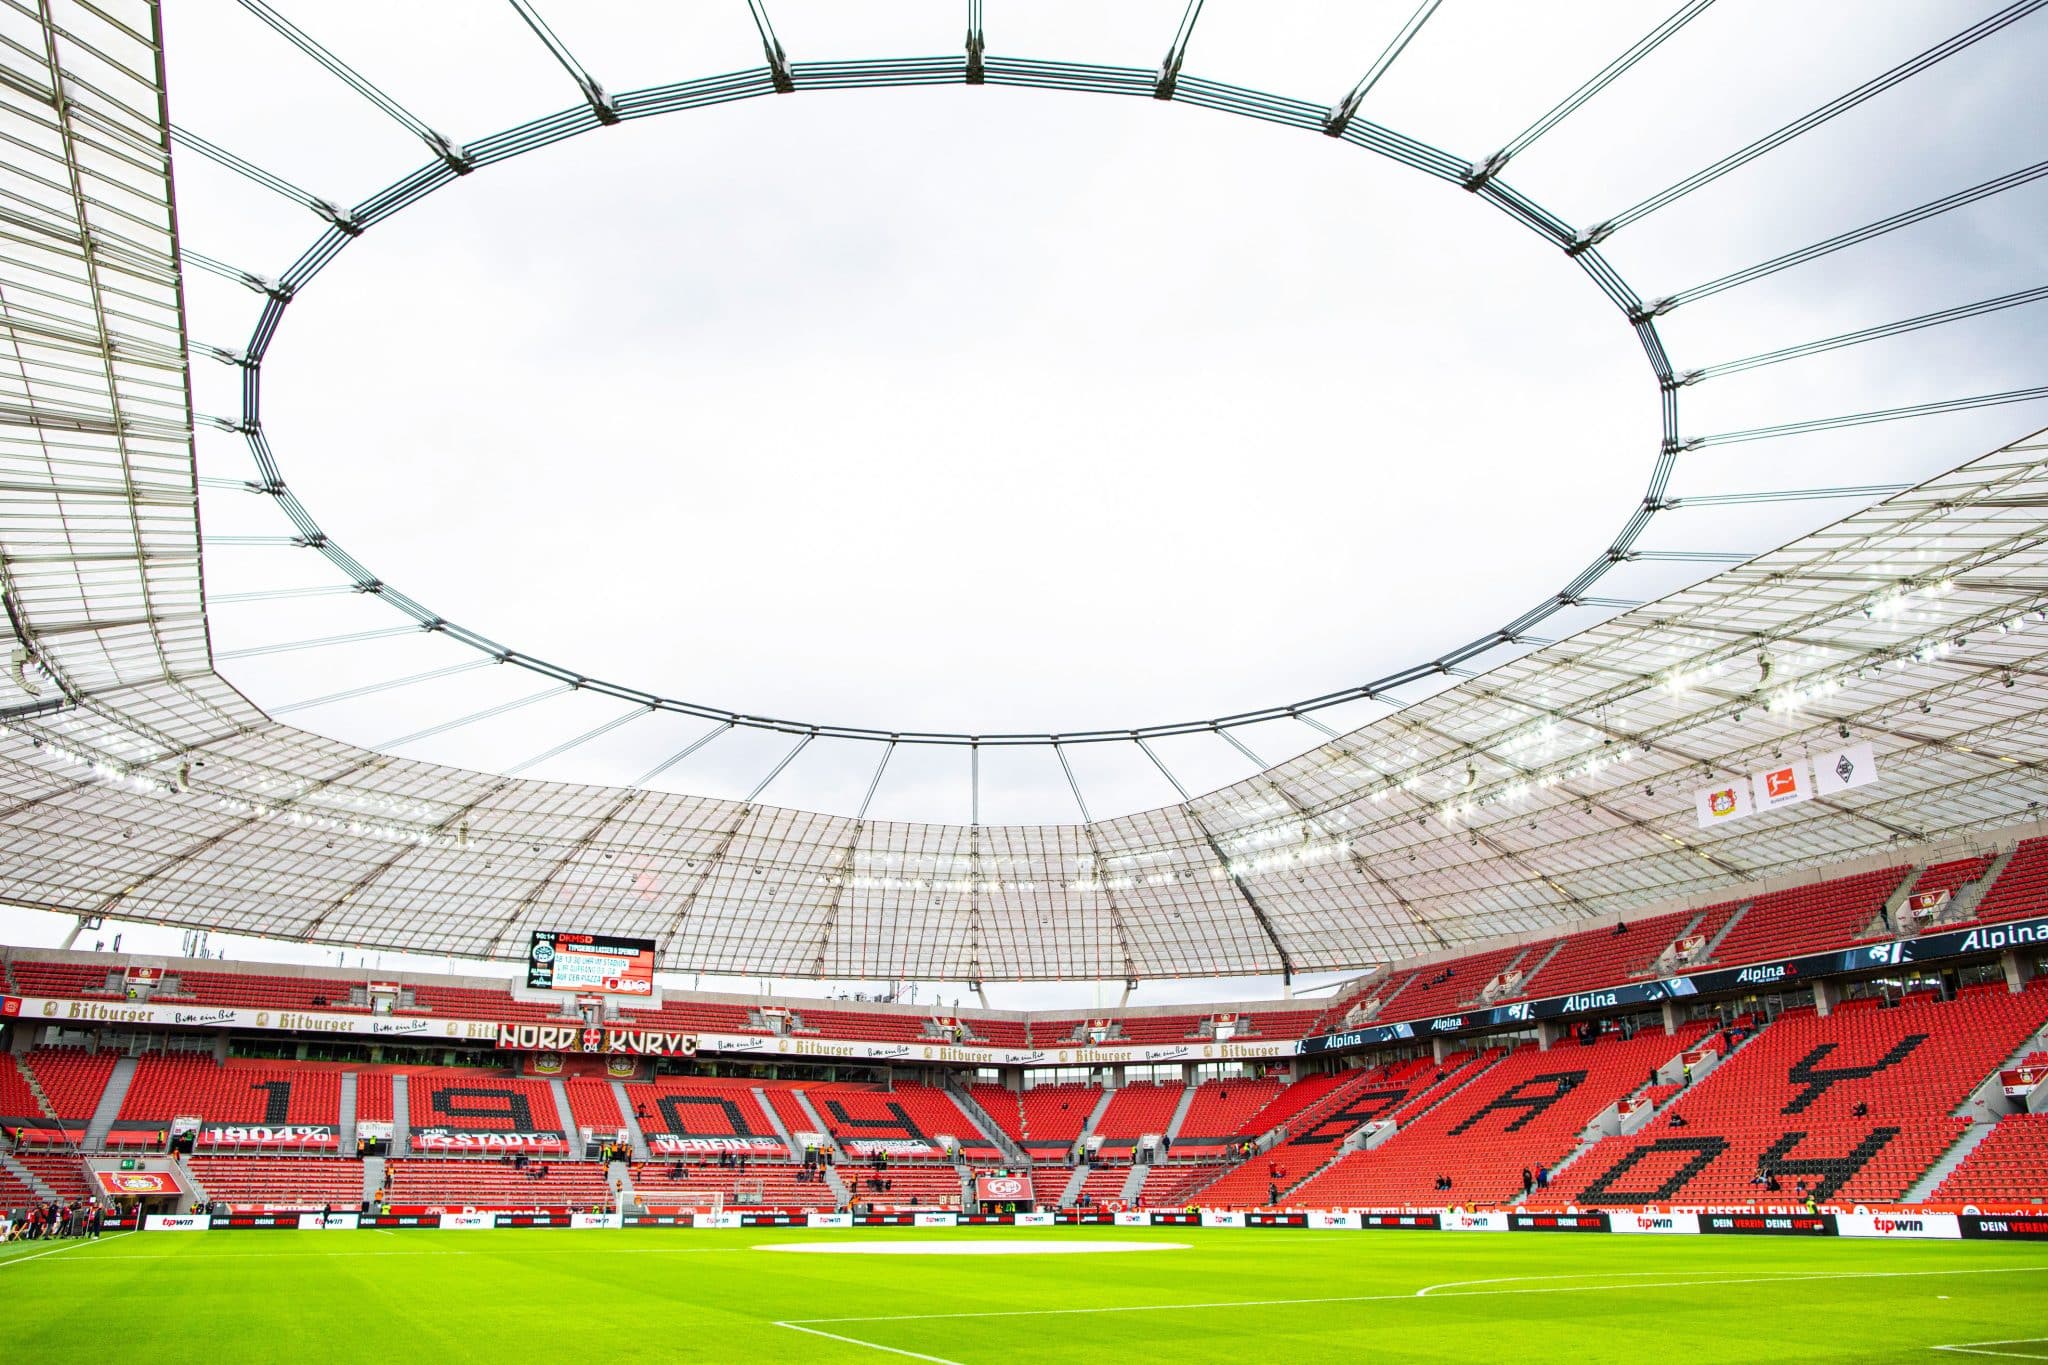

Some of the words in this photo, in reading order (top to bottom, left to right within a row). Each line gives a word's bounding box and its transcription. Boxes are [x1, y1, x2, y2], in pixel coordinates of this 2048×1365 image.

[1961, 920, 2048, 953] Alpina
[1736, 966, 1786, 983] Alpina
[1563, 991, 1618, 1014] Alpina
[68, 1002, 155, 1023] Bitburger
[278, 1013, 355, 1032] Bitburger
[1430, 1017, 1462, 1031] Alpina
[500, 1024, 577, 1049] NORD
[609, 1030, 697, 1056] KURVE
[1324, 1031, 1362, 1050] Alpina
[796, 1040, 854, 1056] Bitburger
[1221, 1045, 1280, 1058] Bitburger
[939, 1048, 993, 1063] Bitburger
[1076, 1050, 1133, 1062] Bitburger
[455, 1132, 538, 1146] STADT
[658, 1138, 752, 1151] VEREIN
[162, 1218, 194, 1227] tipwin
[455, 1217, 481, 1226] tipwin
[1324, 1216, 1346, 1226] tipwin
[1461, 1216, 1488, 1228] tipwin
[1518, 1218, 1533, 1226] DEIN
[1637, 1216, 1672, 1230] tipwin
[1713, 1219, 1733, 1228] DEIN
[1734, 1219, 1765, 1229] VEREIN
[1765, 1219, 1792, 1229] DEINE
[1873, 1217, 1923, 1234] tipwin
[1980, 1221, 2008, 1232] DEIN
[2010, 1223, 2048, 1234] VEREIN
